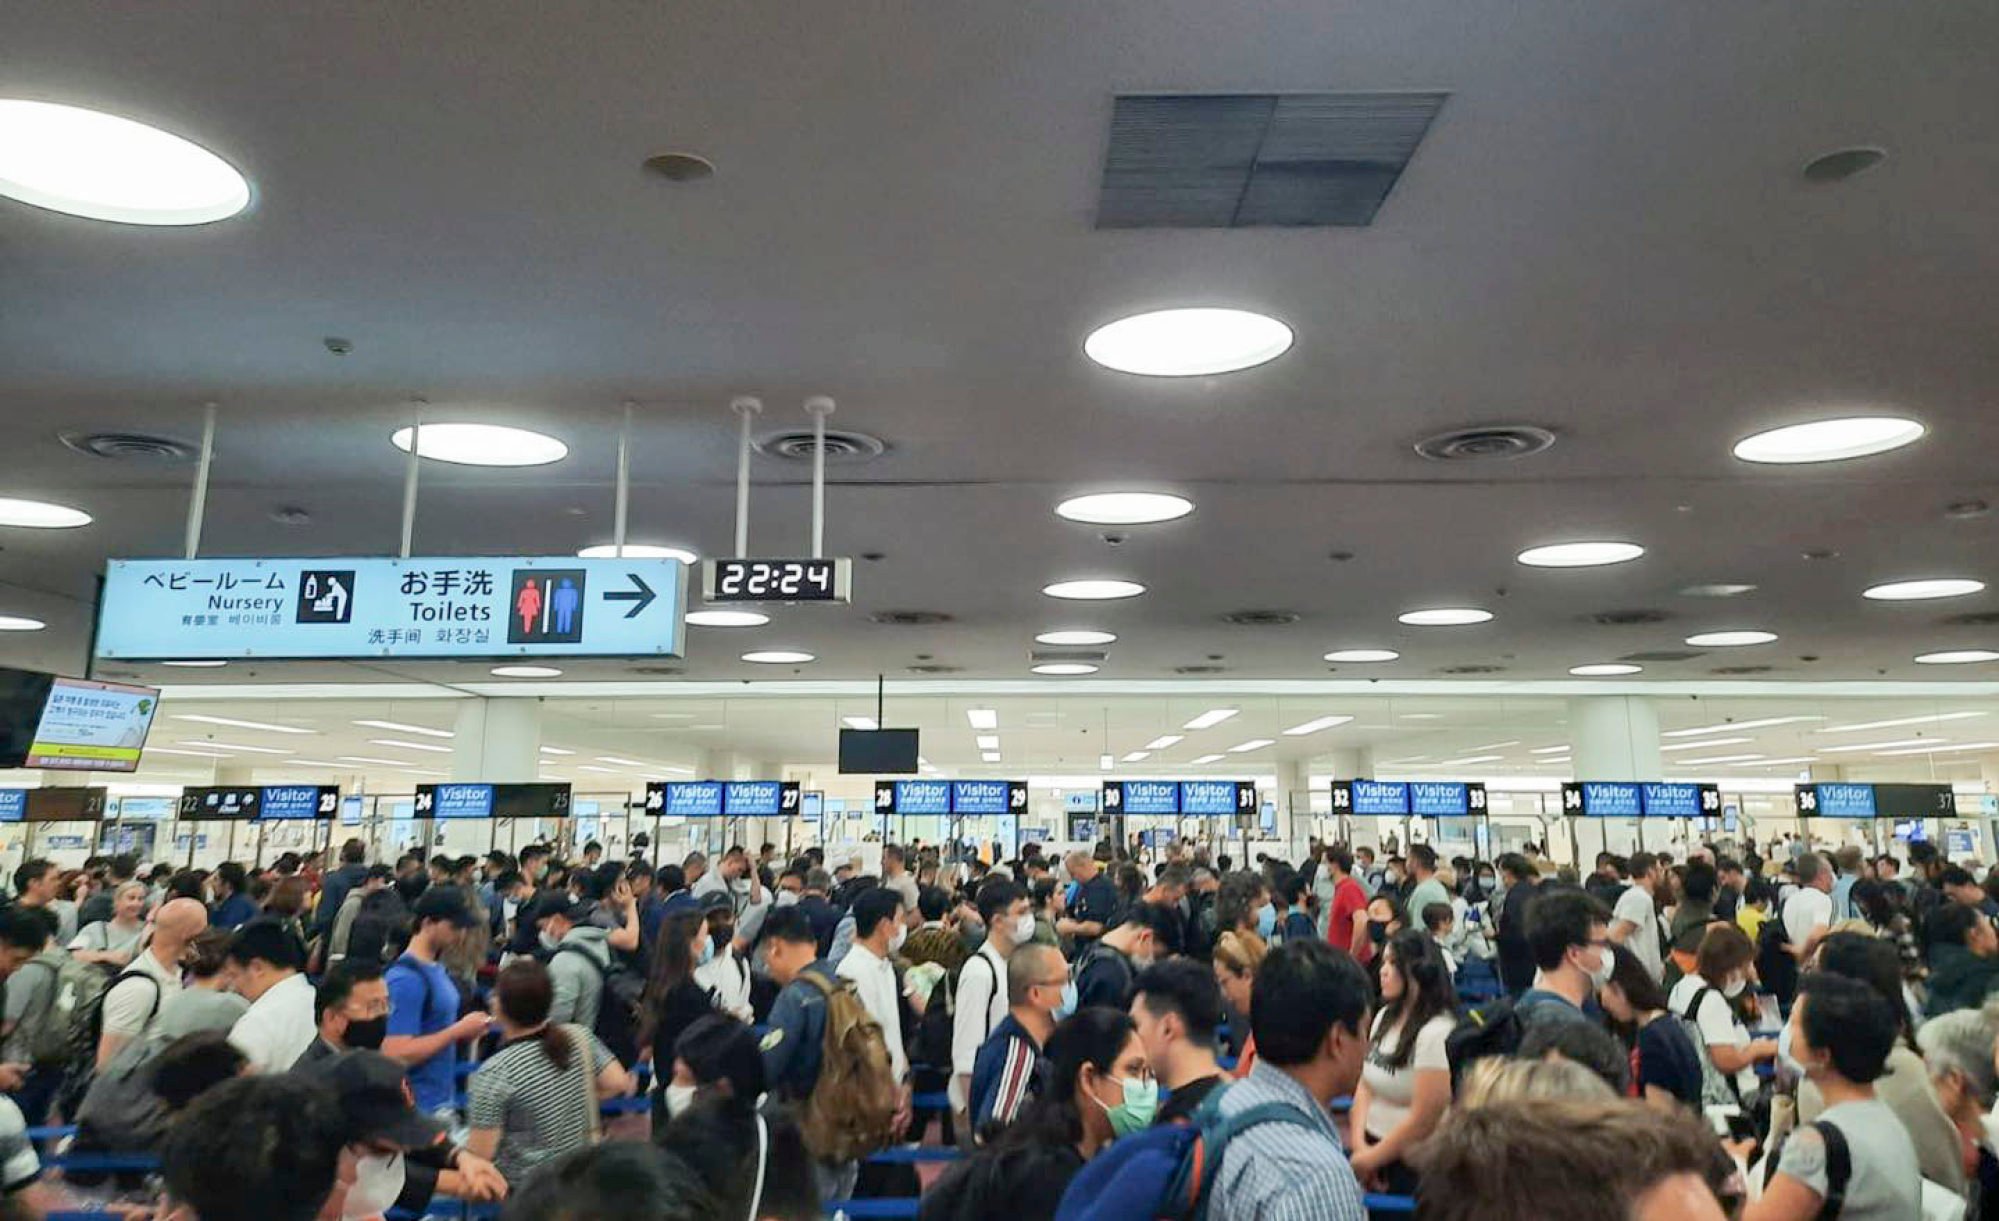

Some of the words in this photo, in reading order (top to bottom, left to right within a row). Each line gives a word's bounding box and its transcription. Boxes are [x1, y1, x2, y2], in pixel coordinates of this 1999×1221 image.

[144, 571, 286, 591] ベビールーム
[400, 569, 494, 597] お手洗
[722, 563, 829, 594] 22:24
[207, 594, 284, 612] Nursery
[409, 601, 491, 622] Toilets
[367, 628, 422, 645] 洗手间
[435, 627, 490, 645] 화장실
[266, 788, 314, 801] Visitor
[440, 787, 488, 800] Visitor
[671, 785, 718, 798] Visitor
[729, 785, 775, 798] Visitor
[876, 789, 892, 807] 28
[900, 783, 946, 798] Visitor
[957, 783, 1003, 797] Visitor
[1010, 789, 1026, 807] 29
[1127, 783, 1174, 797] Visitor
[1185, 783, 1229, 798] Visitor
[1239, 789, 1254, 808] 31
[1356, 784, 1404, 797] Visitor
[1414, 784, 1461, 798] Visitor
[1587, 784, 1635, 798] Visitor
[1647, 785, 1693, 799] Visitor
[1822, 785, 1869, 801] Visitor
[182, 796, 198, 813] 22
[319, 793, 336, 812] 23
[416, 793, 432, 811] 24
[553, 793, 568, 810] 25
[647, 791, 663, 809] 26
[782, 790, 798, 808] 27
[1800, 792, 1816, 810] 36
[1936, 793, 1952, 810] 37
